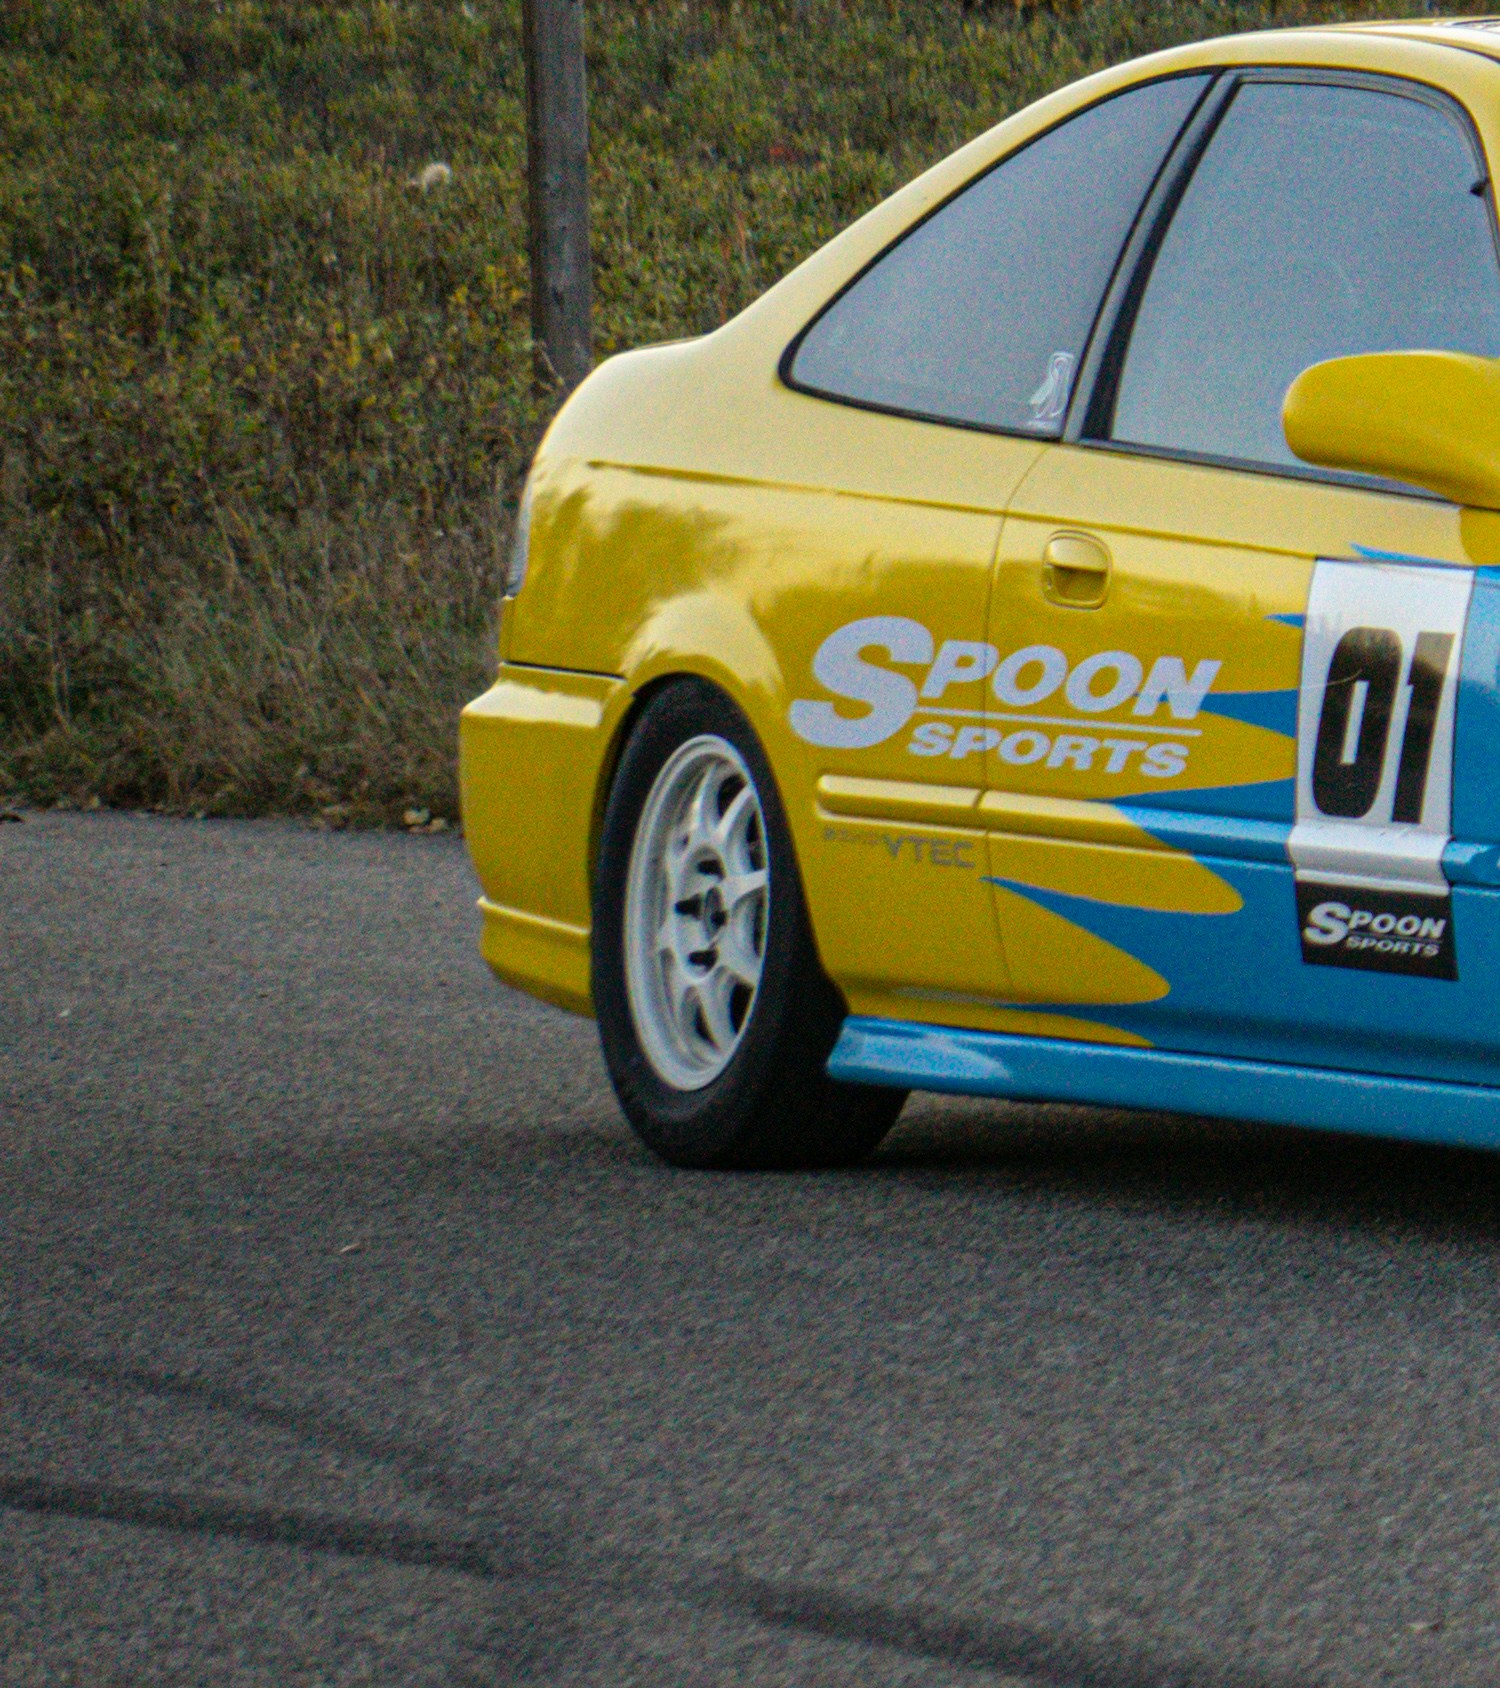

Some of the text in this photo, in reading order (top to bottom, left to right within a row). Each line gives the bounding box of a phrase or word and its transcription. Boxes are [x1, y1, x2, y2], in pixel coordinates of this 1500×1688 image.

[788, 615, 1223, 749] SPOON
[907, 721, 1191, 778] SPORTS
[1311, 626, 1456, 824] 01
[883, 833, 976, 870] VTEC
[1302, 901, 1447, 945] SPOON
[1345, 934, 1441, 958] SPORTS
